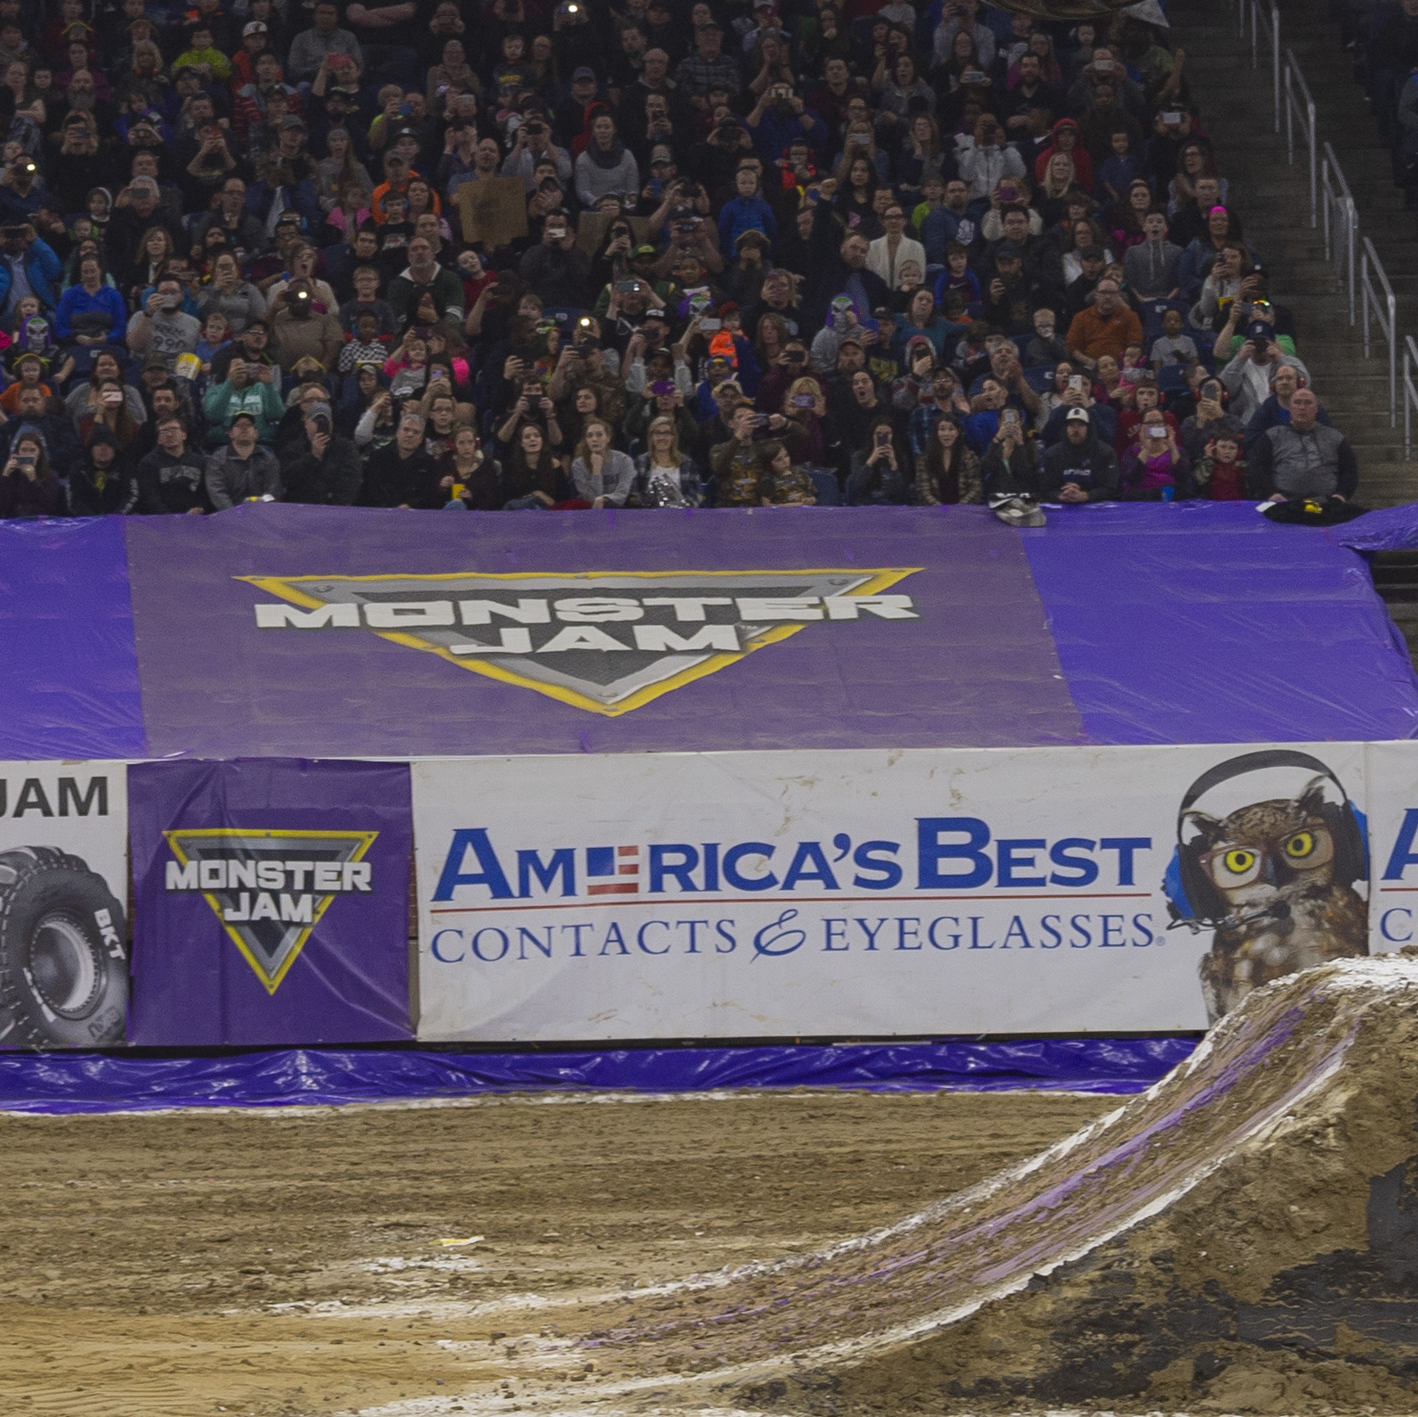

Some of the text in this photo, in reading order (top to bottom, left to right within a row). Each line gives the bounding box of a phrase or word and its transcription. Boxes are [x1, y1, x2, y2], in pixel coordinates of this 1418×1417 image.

[253, 593, 922, 630] MONSTER
[449, 623, 743, 656] JAM
[164, 859, 373, 892] MONSTER
[429, 815, 1154, 903] AMERICA'S BEST
[223, 892, 314, 924] JAM
[92, 906, 128, 962] BKT
[430, 908, 1156, 966] CONTACTS & EYEGLASSES
